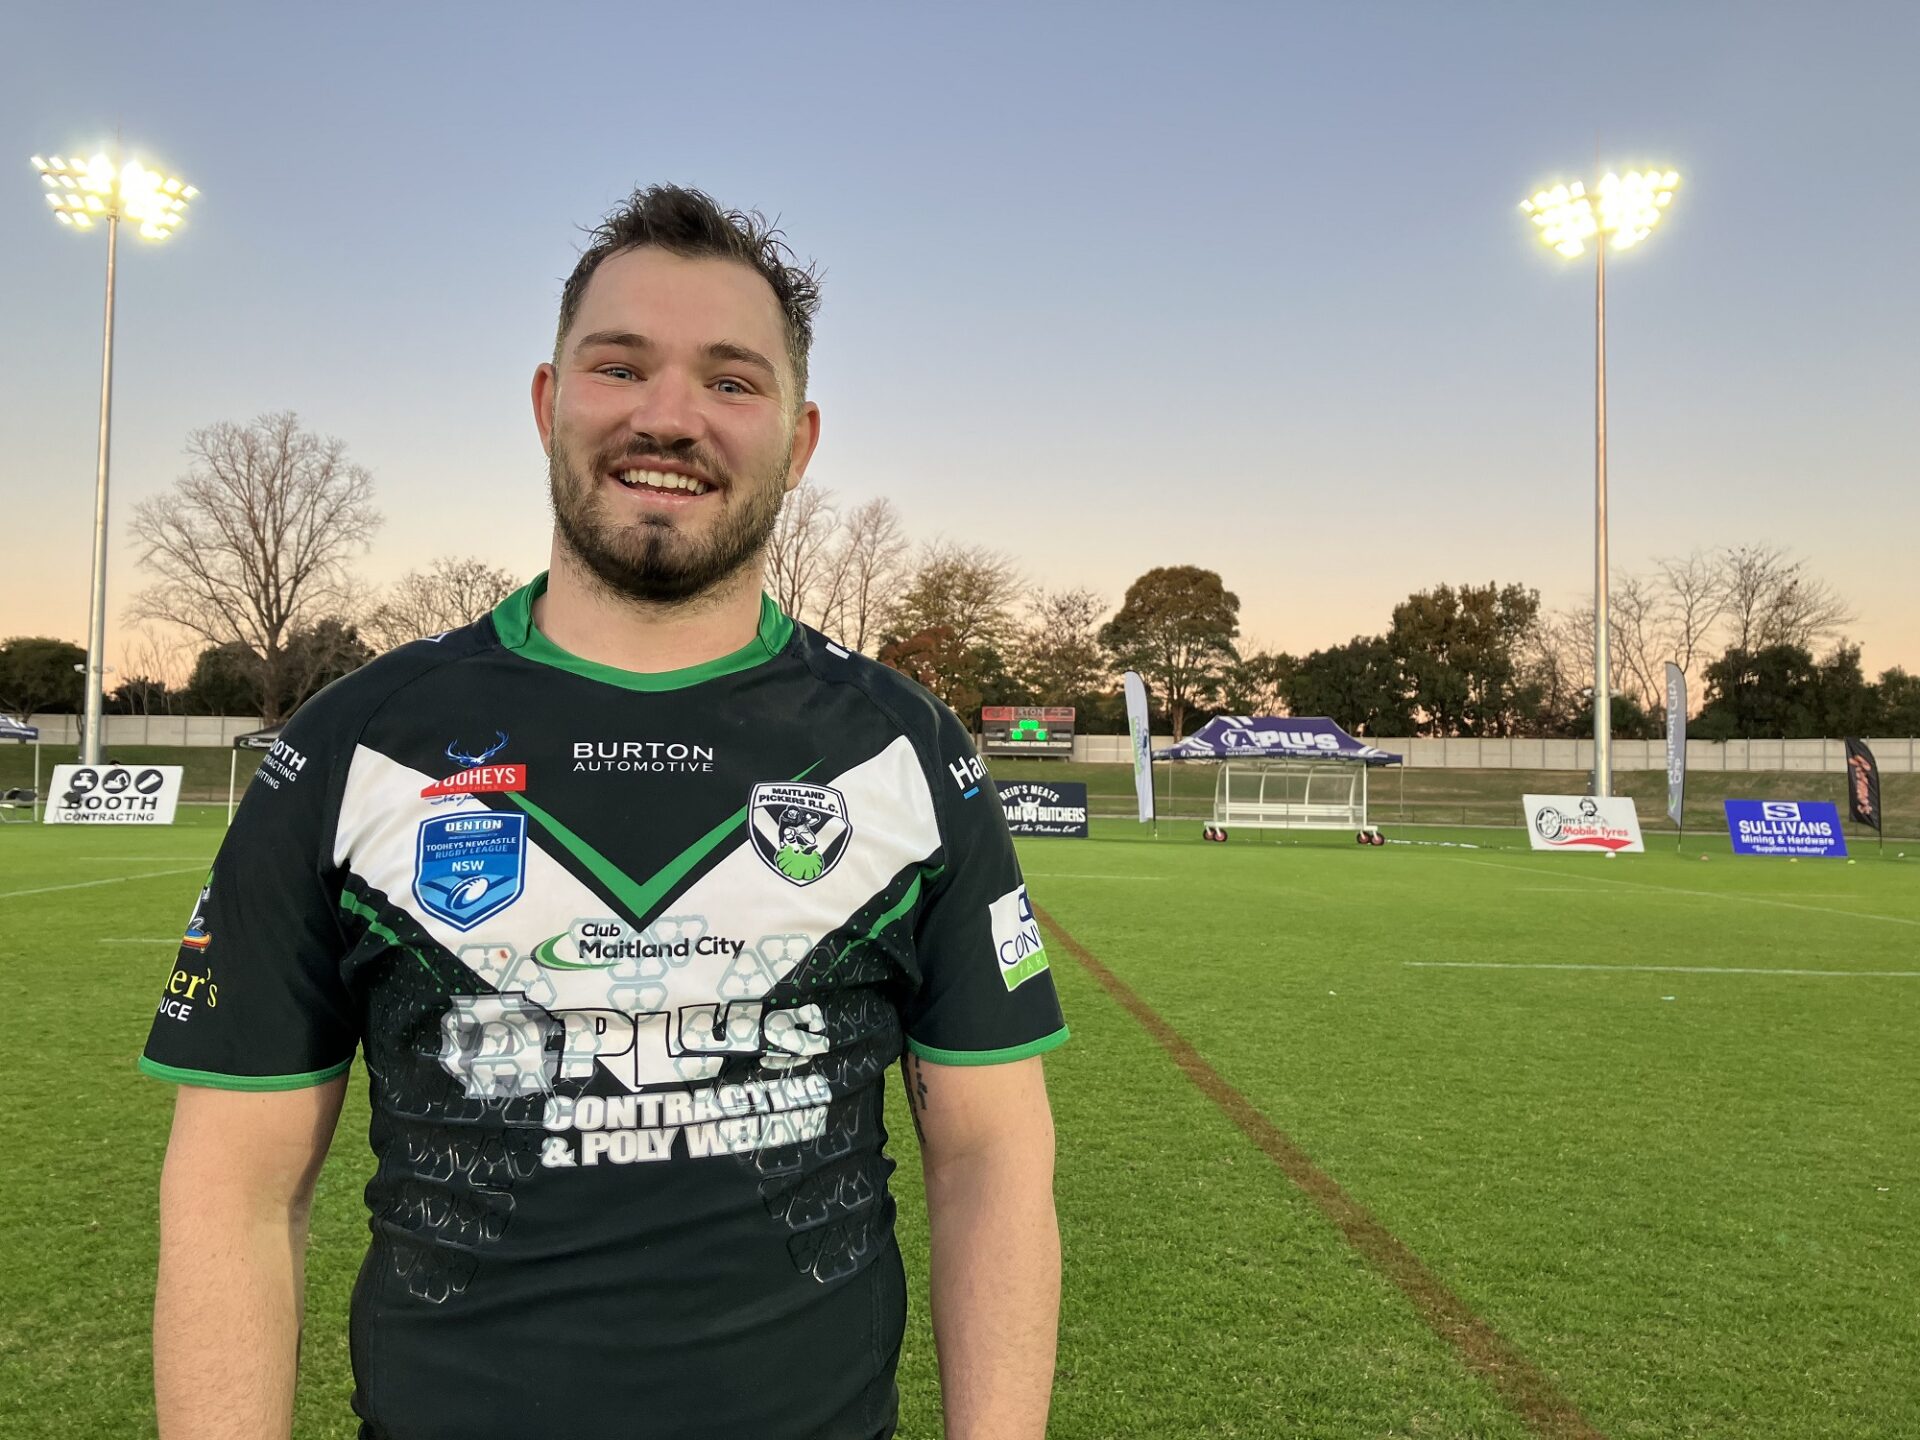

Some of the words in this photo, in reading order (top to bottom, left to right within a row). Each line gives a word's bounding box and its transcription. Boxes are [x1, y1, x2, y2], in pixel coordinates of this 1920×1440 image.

[573, 742, 713, 761] BURTON
[573, 761, 714, 772] AUTOMOTIVE
[772, 788, 826, 800] MAITLAND
[999, 785, 1028, 800] REID'S
[1030, 785, 1060, 802] MEATS
[759, 795, 805, 805] PICKERS
[808, 800, 839, 814] R.L.C.
[64, 812, 155, 822] CONTRACTING
[1038, 807, 1086, 822] BUTCHERS
[445, 820, 502, 832] DENTON
[1562, 826, 1598, 836] Mobile
[1600, 827, 1629, 838] Tyres
[1738, 820, 1833, 836] SULLIVANS
[426, 841, 464, 852] TOOHEYS
[465, 836, 517, 847] NEWCASTLE
[1740, 834, 1775, 844] Mining
[1777, 835, 1785, 845] &
[1787, 836, 1835, 845] Hardware
[435, 848, 467, 859] RUGBY
[470, 844, 508, 854] LEAGUE
[451, 860, 485, 872] NSW
[581, 923, 621, 936] Club
[579, 938, 690, 959] Maitland
[695, 936, 746, 960] City
[543, 1074, 832, 1131] CONTRACTING
[541, 1136, 577, 1168] &
[581, 1127, 681, 1166] POLY
